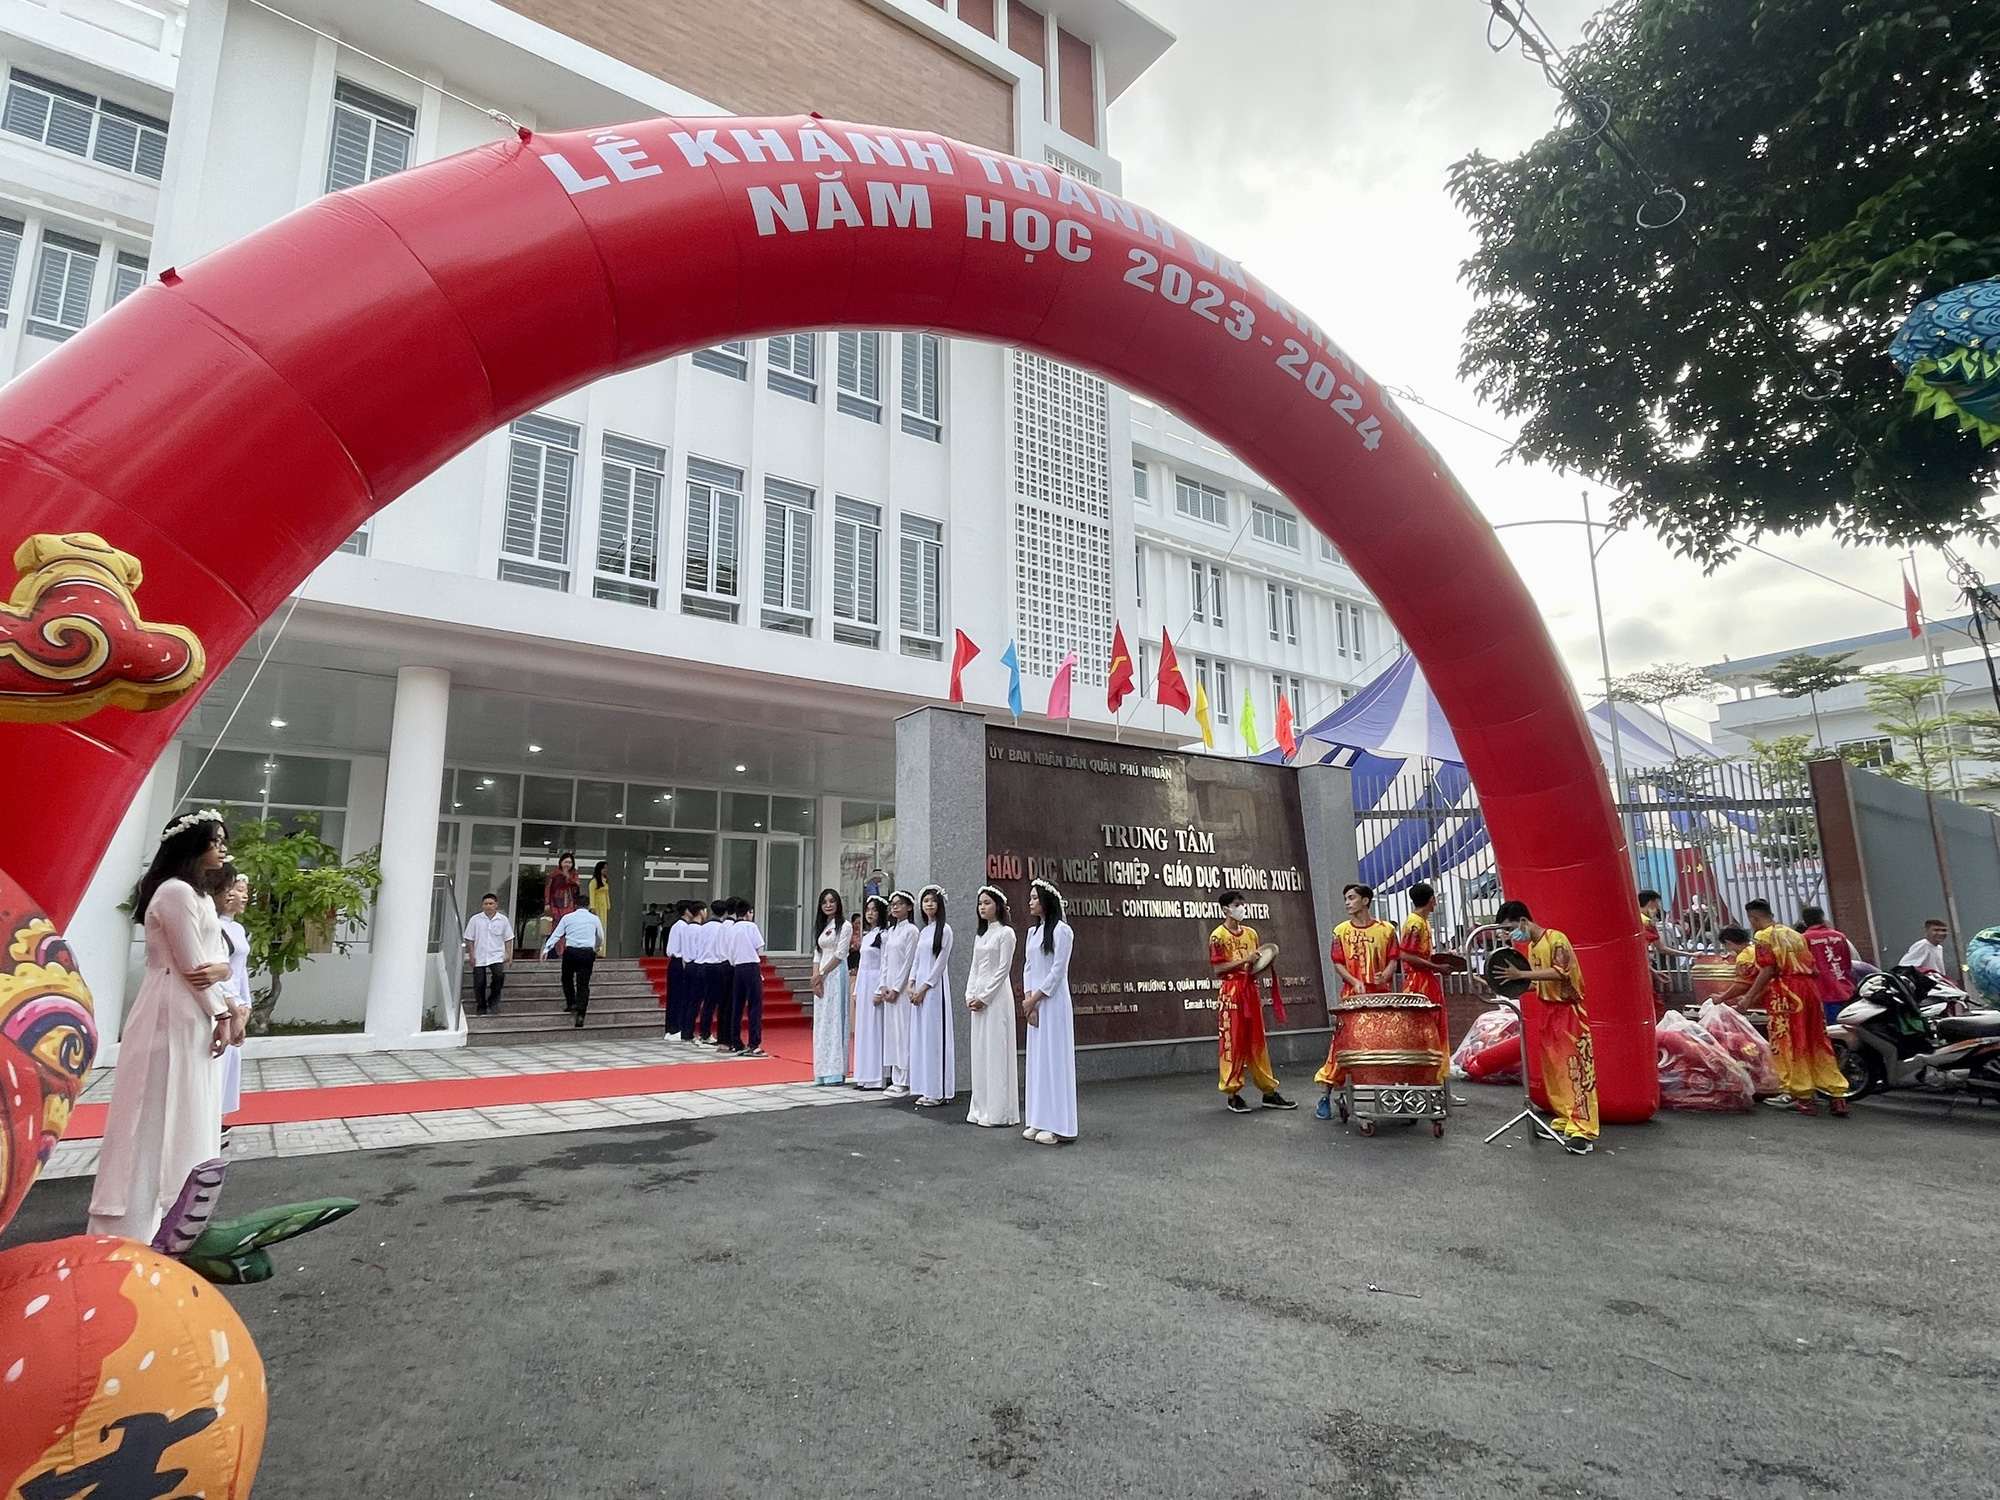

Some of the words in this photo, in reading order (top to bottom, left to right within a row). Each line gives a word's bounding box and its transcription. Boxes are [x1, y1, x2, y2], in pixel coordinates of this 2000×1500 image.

[541, 129, 663, 195] LỄ
[670, 122, 954, 175] KHÁNH
[747, 171, 933, 236] NĂM
[965, 194, 1092, 263] HỌC
[1123, 248, 1256, 341] 2023
[1276, 338, 1384, 452] 2024
[1008, 748, 1031, 764] BAN
[1034, 751, 1063, 768] NHÂN
[1065, 754, 1087, 770] DÂN
[1089, 758, 1116, 775] QUẬN
[1120, 762, 1139, 777] PHÚ
[1141, 765, 1172, 782] NHUẬN
[1100, 823, 1169, 851] TRUNG
[1174, 825, 1216, 854] TÂM
[987, 850, 1023, 880] GIÁO
[1062, 852, 1099, 884] NGHỀ
[1104, 857, 1150, 890] NGHIỆP
[1163, 859, 1193, 888] GIÁO
[1195, 865, 1221, 893] DỤC
[1223, 863, 1269, 891] THƯỜNG
[1270, 866, 1306, 892] XUYÊN
[1122, 899, 1182, 918] CONTINUING
[1183, 901, 1226, 919] EDUCATI
[1244, 903, 1270, 919] ENTER
